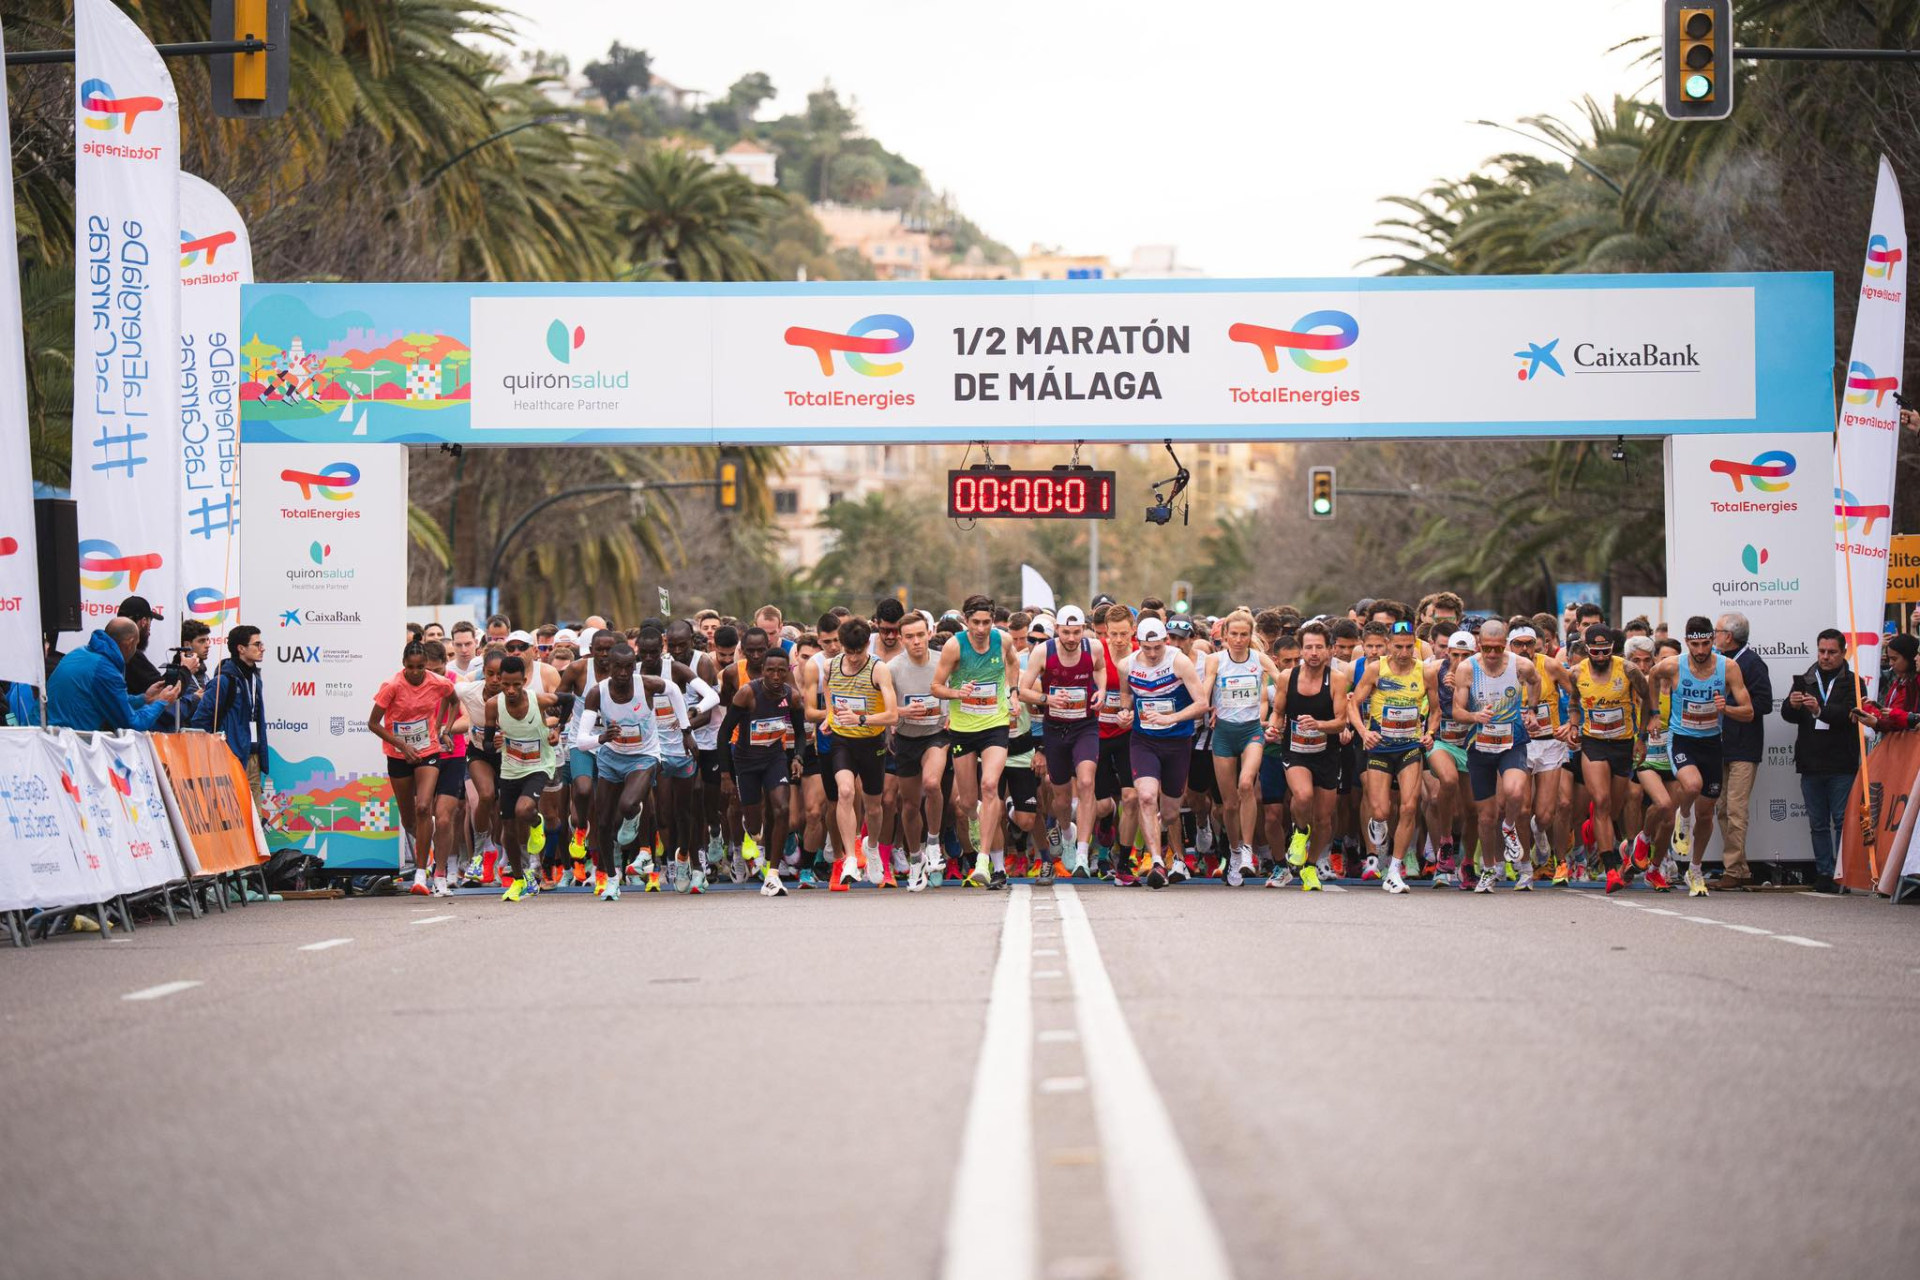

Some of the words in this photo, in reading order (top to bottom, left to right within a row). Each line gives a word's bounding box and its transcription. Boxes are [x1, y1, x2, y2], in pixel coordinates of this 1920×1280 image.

[953, 326, 1006, 355] 1/2
[1017, 319, 1190, 355] MARATÓN
[1573, 343, 1700, 367] CaixaBank
[503, 370, 629, 395] quirónsalud
[955, 373, 999, 401] DE
[1009, 366, 1162, 401] MÁLAGA
[785, 390, 915, 410] TotalEnergies
[1229, 386, 1360, 406] TotalEnergies
[513, 399, 575, 411] Healthcare
[578, 399, 619, 411] Partner
[955, 477, 1109, 513] 00:00:01
[1711, 500, 1798, 514] TotalEnergies
[281, 508, 361, 521] TotalEnergies
[286, 568, 355, 581] quirónsalud
[1712, 578, 1799, 596] quirónsalud
[1720, 599, 1762, 607] Healthcare
[1764, 598, 1793, 607] Partner
[305, 610, 362, 622] CaixaBank
[277, 646, 320, 663] UAX
[325, 689, 353, 697] Málaga
[1232, 690, 1250, 699] F14
[975, 697, 987, 706] 35
[404, 735, 422, 744] F16
[1768, 745, 1794, 754] met
[1768, 756, 1795, 766] Mála
